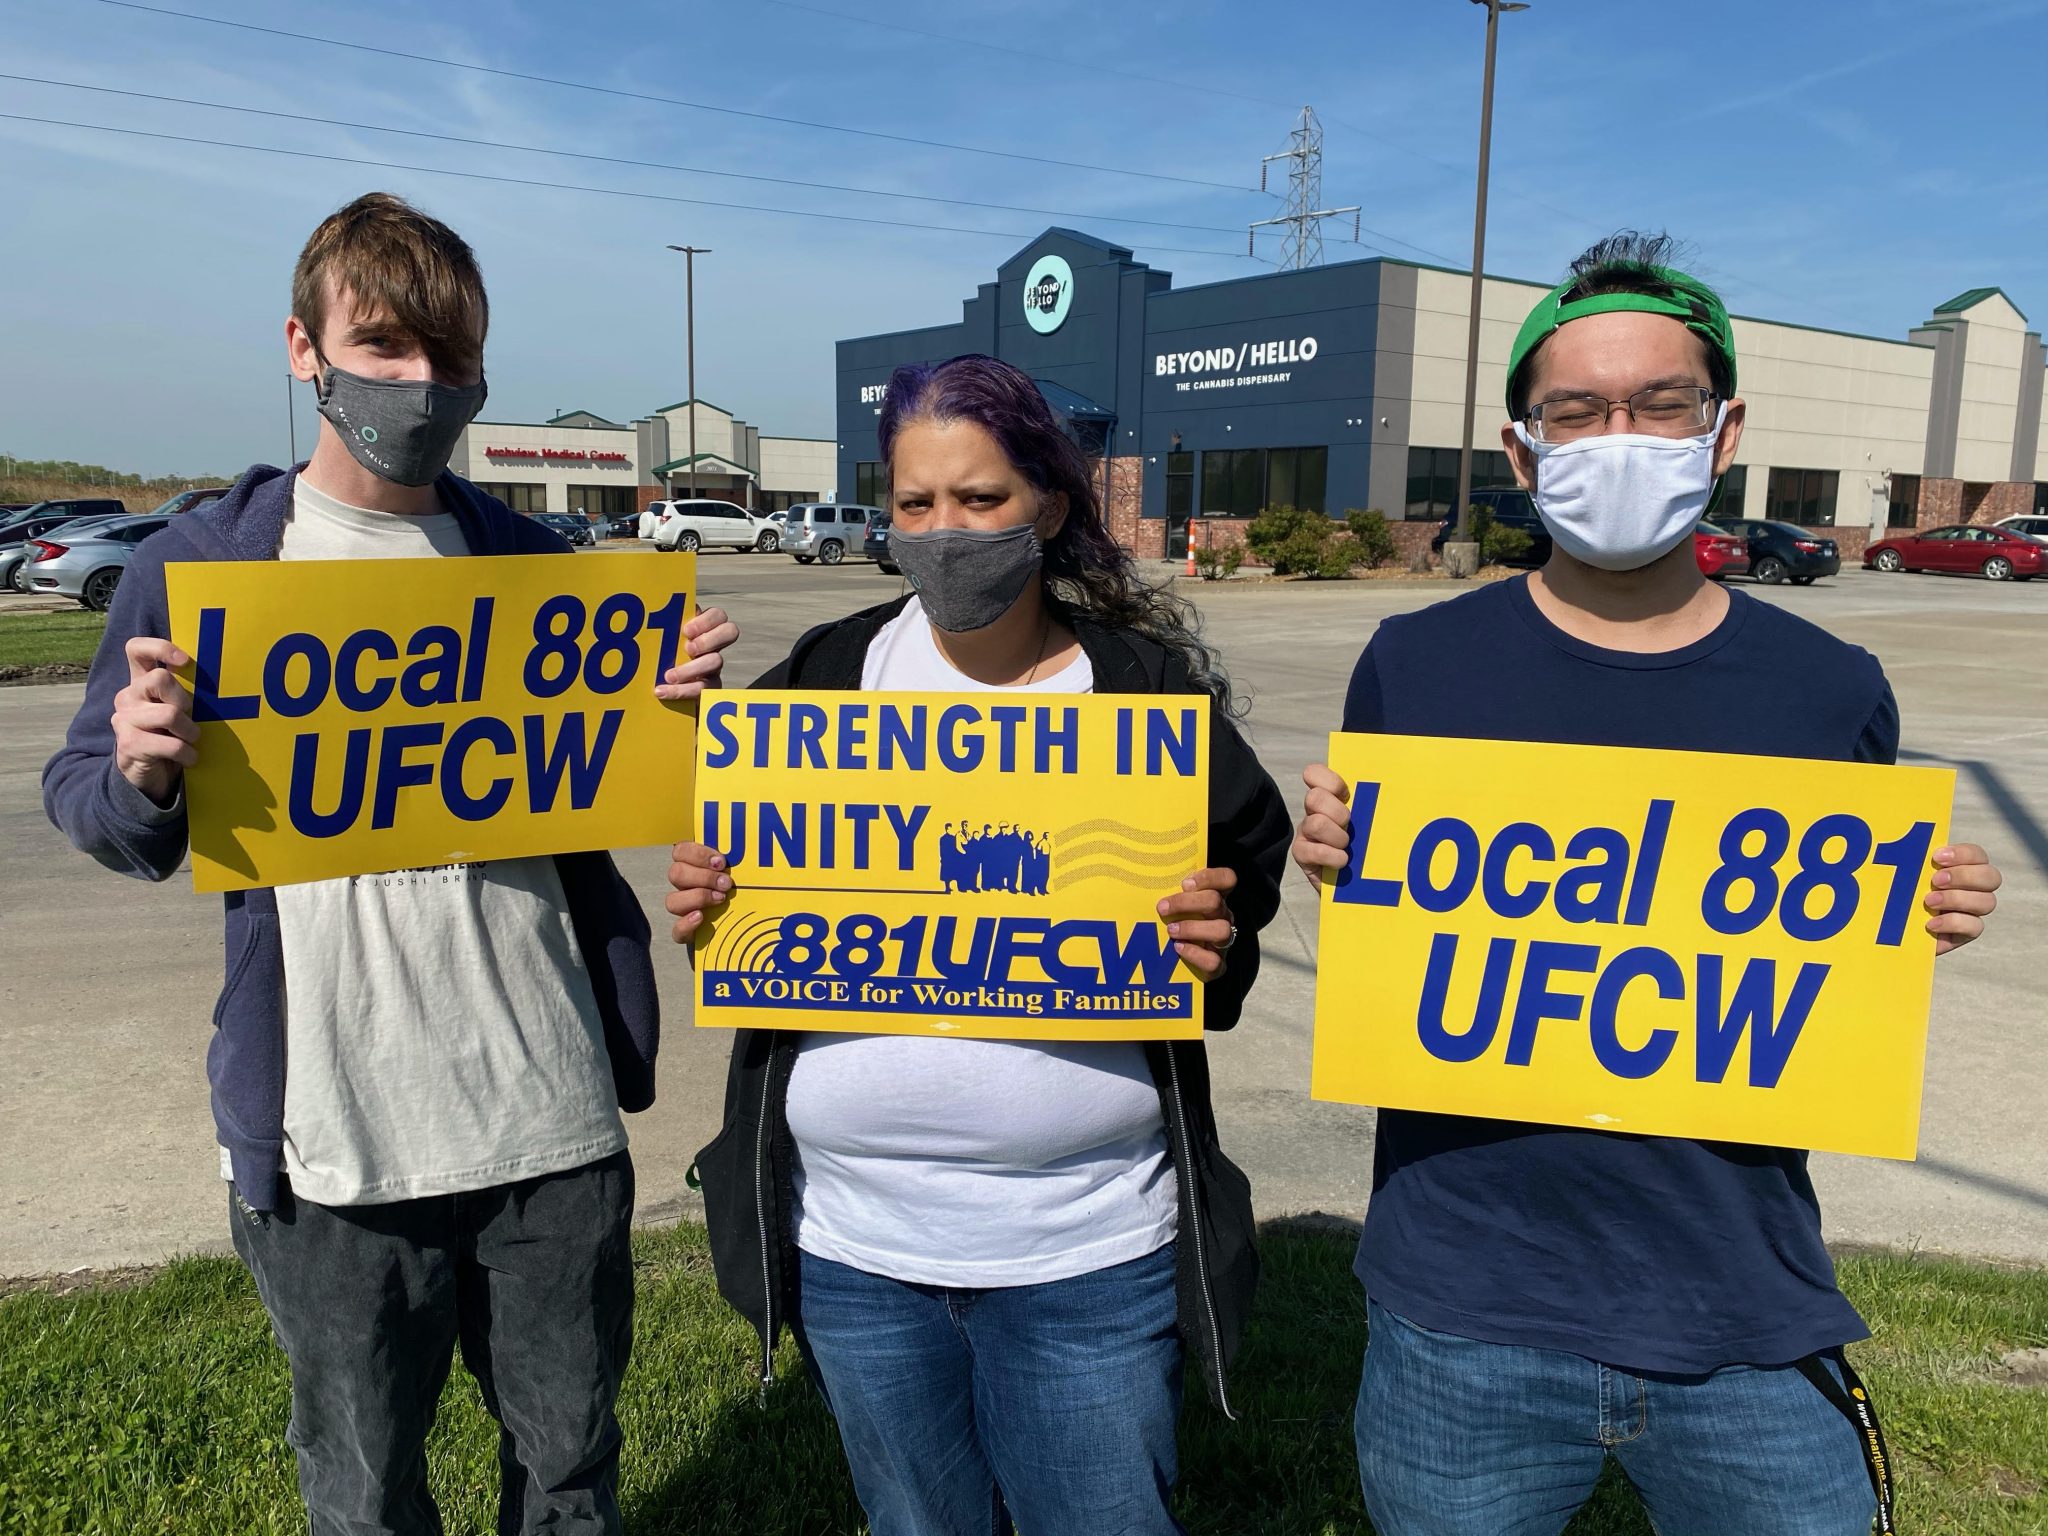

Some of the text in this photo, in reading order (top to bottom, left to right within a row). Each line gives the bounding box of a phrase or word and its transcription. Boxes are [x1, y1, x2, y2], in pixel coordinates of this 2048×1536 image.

[1026, 295, 1053, 308] HELLO
[1176, 372, 1291, 392] THE CANNABIS DISPENSARY
[541, 448, 586, 460] Medical
[589, 449, 627, 462] Center
[194, 592, 687, 721] Local 881
[705, 701, 1197, 776] STRENGTH IN
[289, 710, 624, 838] UFCW
[703, 801, 932, 870] UNITY
[1333, 782, 1935, 947] Local 881
[374, 877, 427, 887] JUSHI
[442, 872, 487, 884] BRAND
[714, 977, 1180, 1014] a VOICE for Working Families
[1416, 933, 1831, 1089] UFCW
